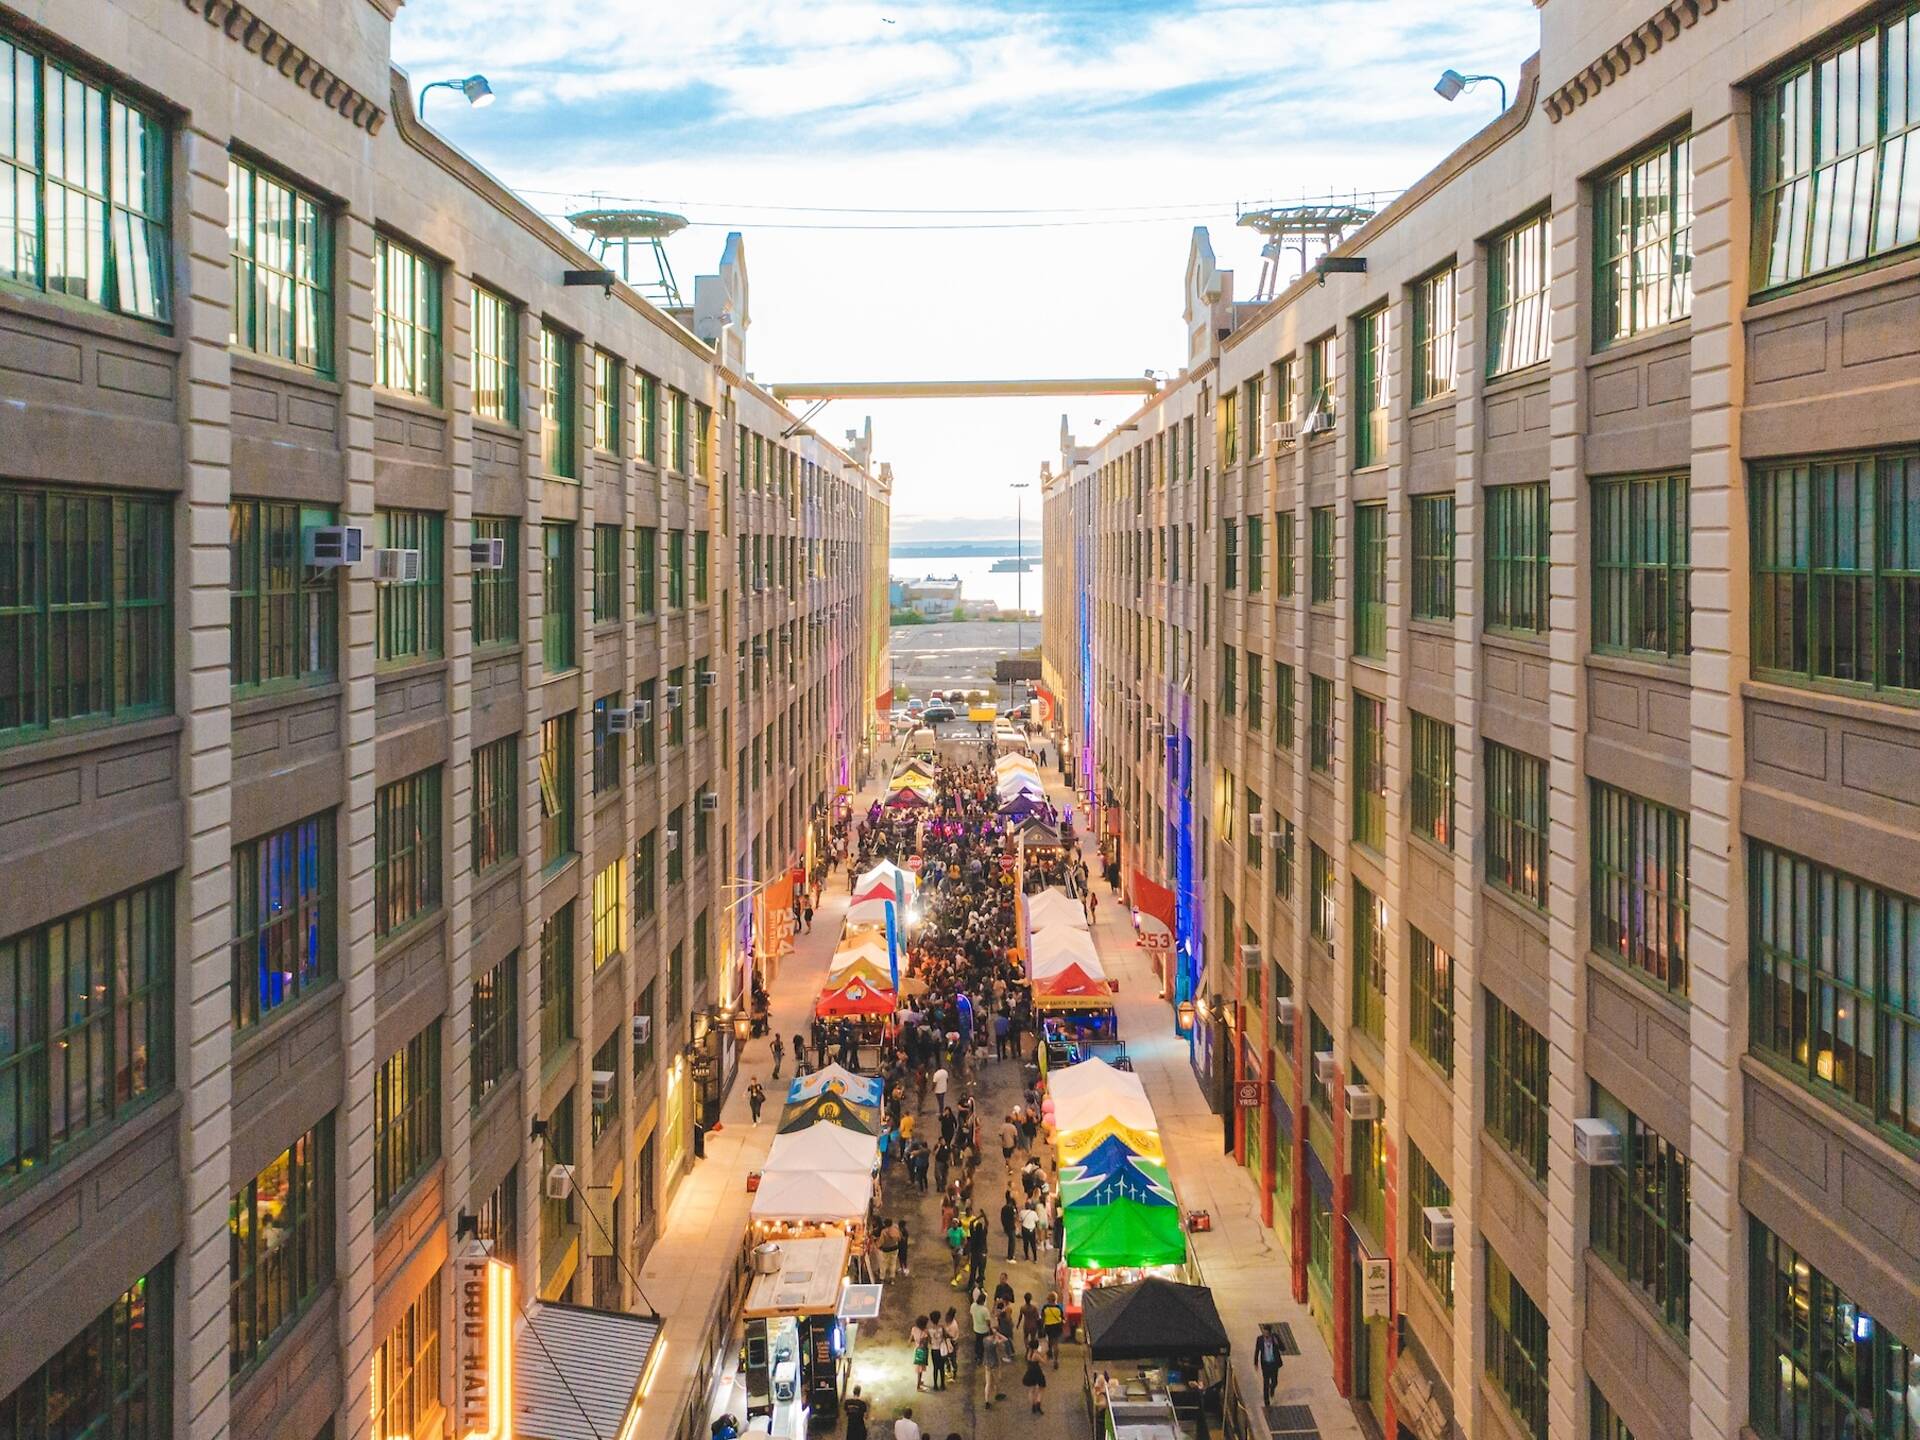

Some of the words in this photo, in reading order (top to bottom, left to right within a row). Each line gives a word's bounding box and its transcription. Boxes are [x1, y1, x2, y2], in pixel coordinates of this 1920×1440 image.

[777, 908, 795, 957] 254
[1136, 932, 1170, 948] 253
[464, 1263, 485, 1338] FOOD
[464, 1354, 486, 1425] HALL
